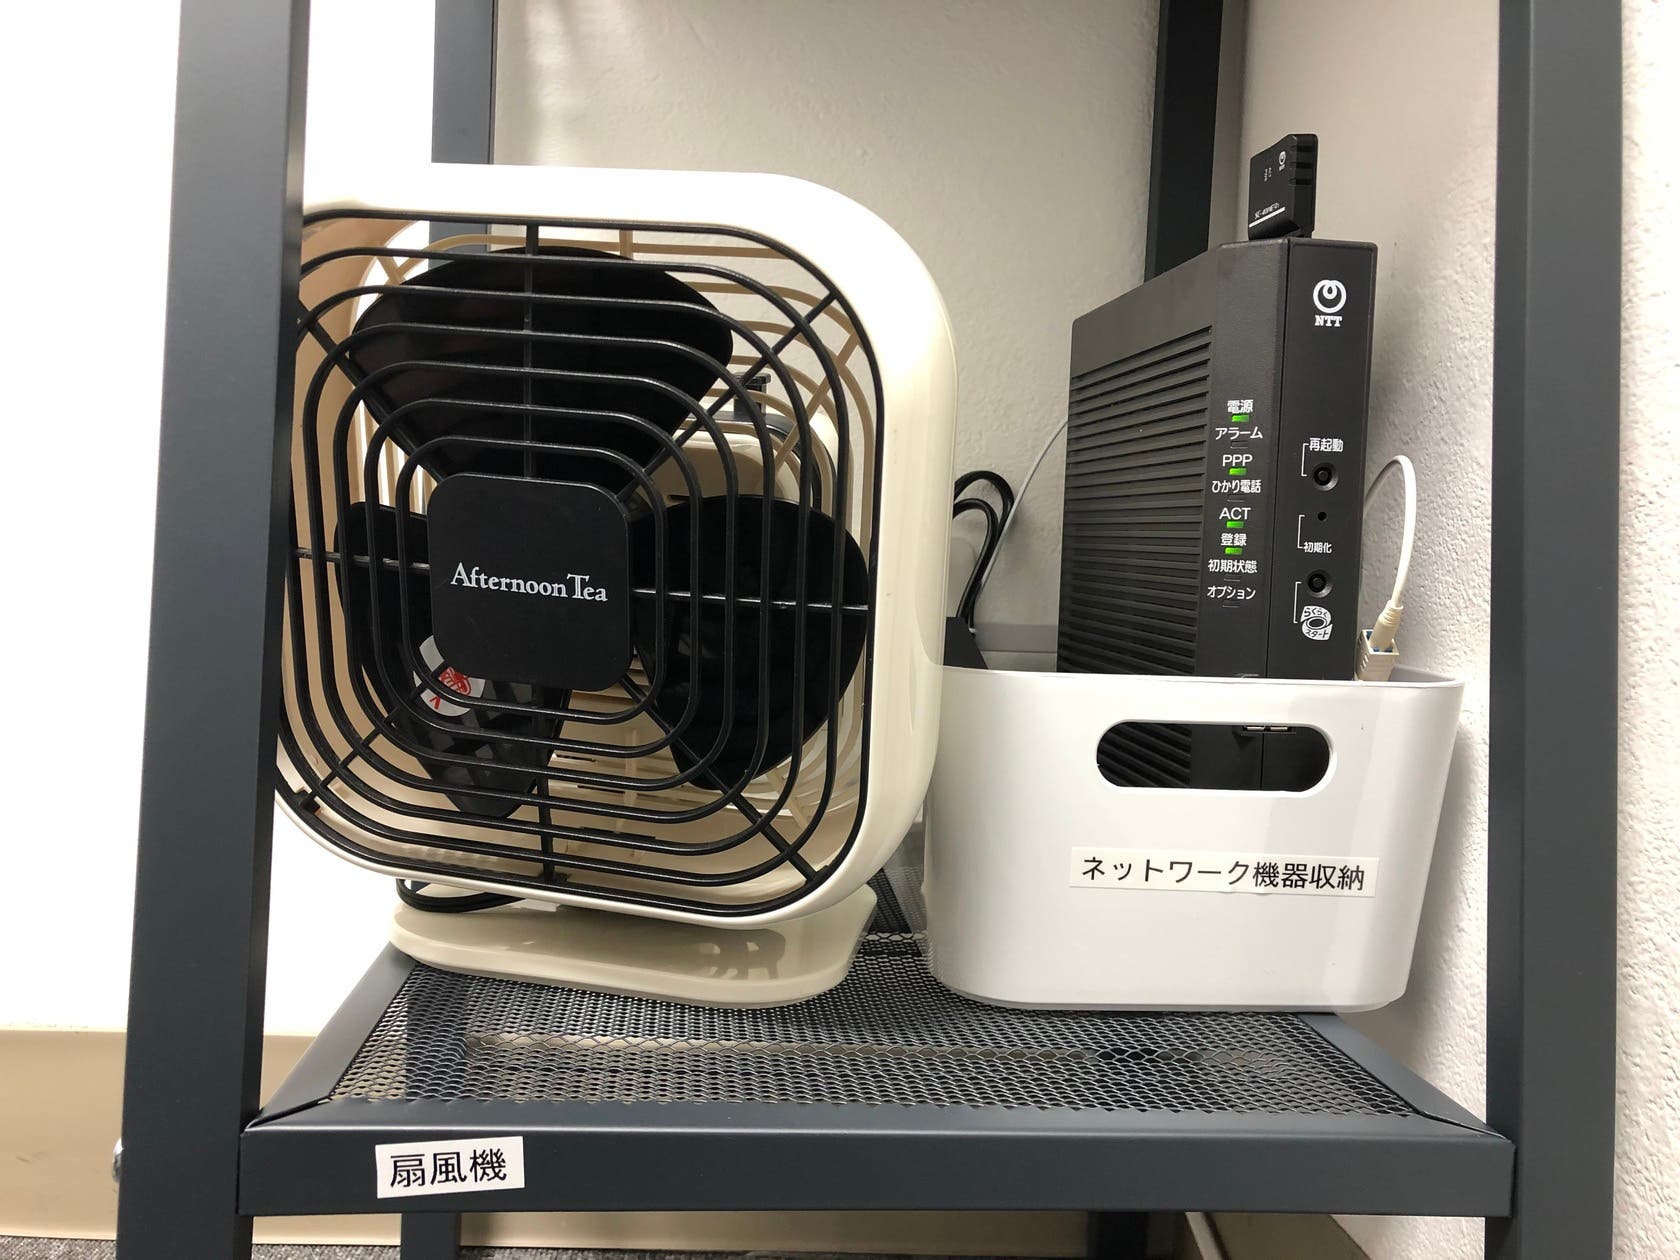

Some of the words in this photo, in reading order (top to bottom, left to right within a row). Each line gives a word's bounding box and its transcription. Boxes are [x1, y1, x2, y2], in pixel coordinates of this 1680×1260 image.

[1314, 314, 1343, 327] NTT
[1227, 400, 1254, 413] 電源
[1215, 426, 1263, 440] アラーム
[1309, 437, 1344, 452] 再起動
[1222, 454, 1253, 467] PPP
[1211, 479, 1262, 494] ひかり電話
[1219, 507, 1251, 520] ACT
[1221, 533, 1247, 546] 登録
[1303, 541, 1333, 553] 初期化
[1207, 559, 1258, 574] 初期状態
[450, 562, 568, 598] Afternoon
[566, 573, 608, 602] Tea
[1207, 585, 1256, 600] オプション
[1081, 856, 1365, 891] ネットワーク機器収納
[390, 1148, 507, 1188] 扇風機
